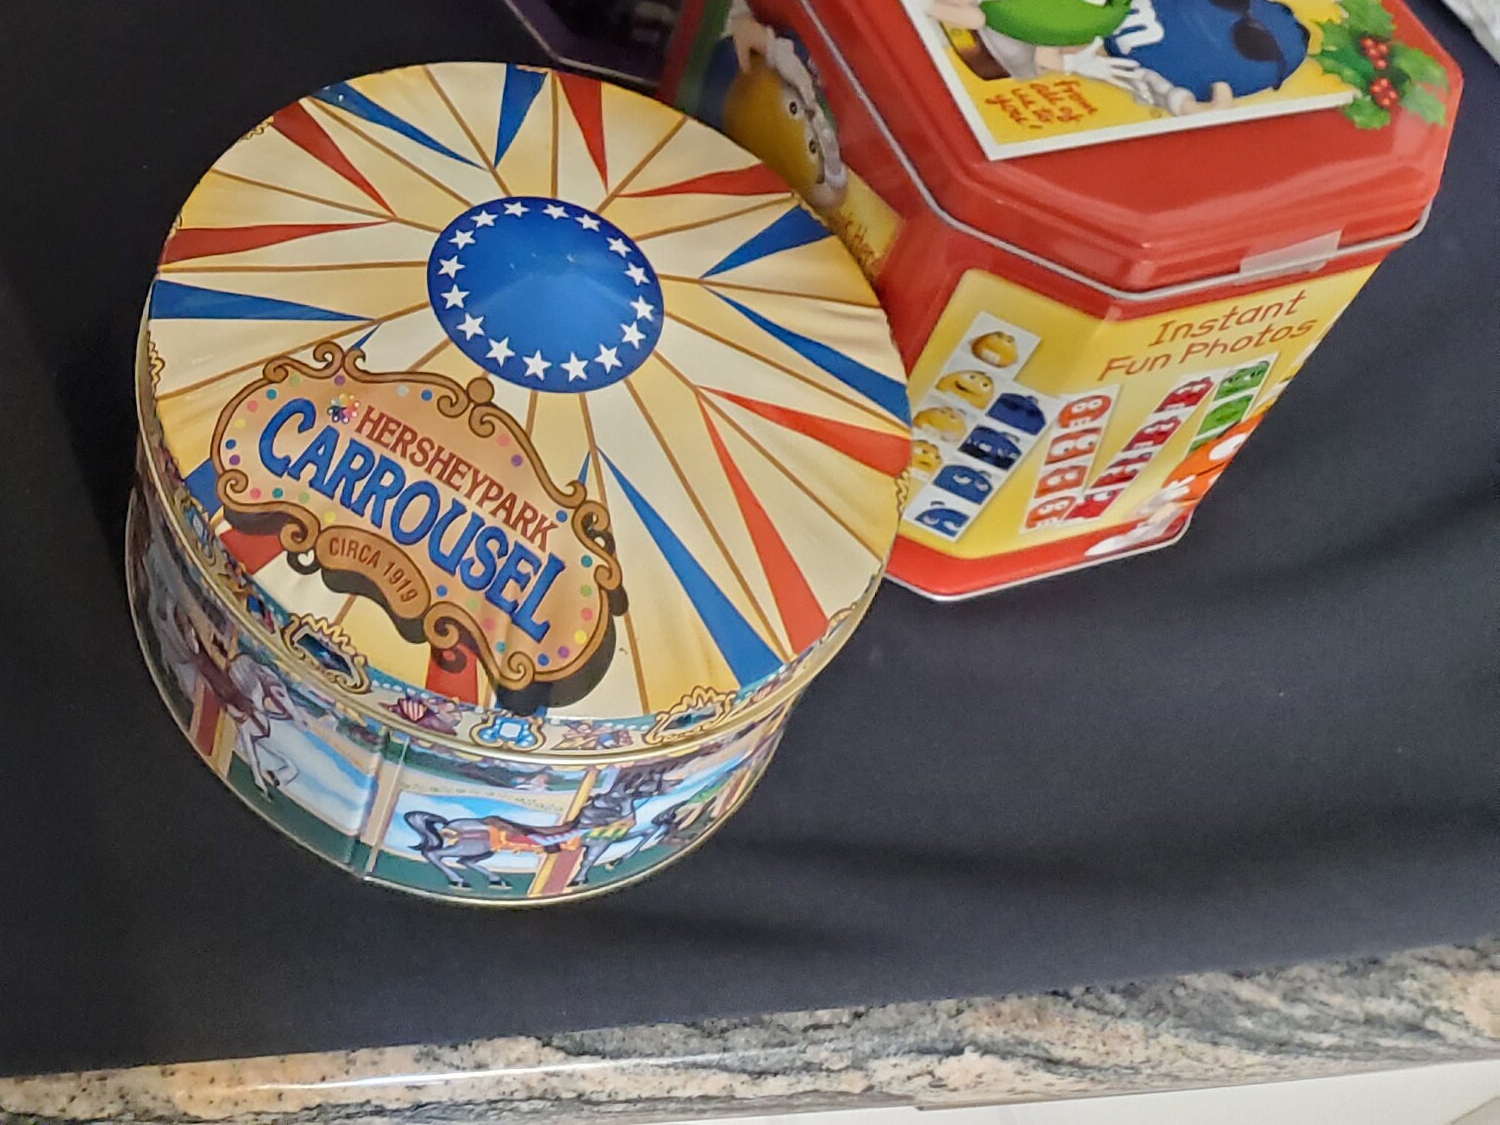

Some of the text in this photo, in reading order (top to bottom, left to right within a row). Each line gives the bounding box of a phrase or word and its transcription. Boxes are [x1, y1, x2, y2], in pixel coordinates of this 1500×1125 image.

[1097, 318, 1319, 382] Fun Photos
[1148, 289, 1307, 347] Instant
[354, 405, 561, 555] HERSHEYPARK
[257, 396, 568, 644] CARROUSEL
[328, 535, 420, 604] CIRCA 1919
